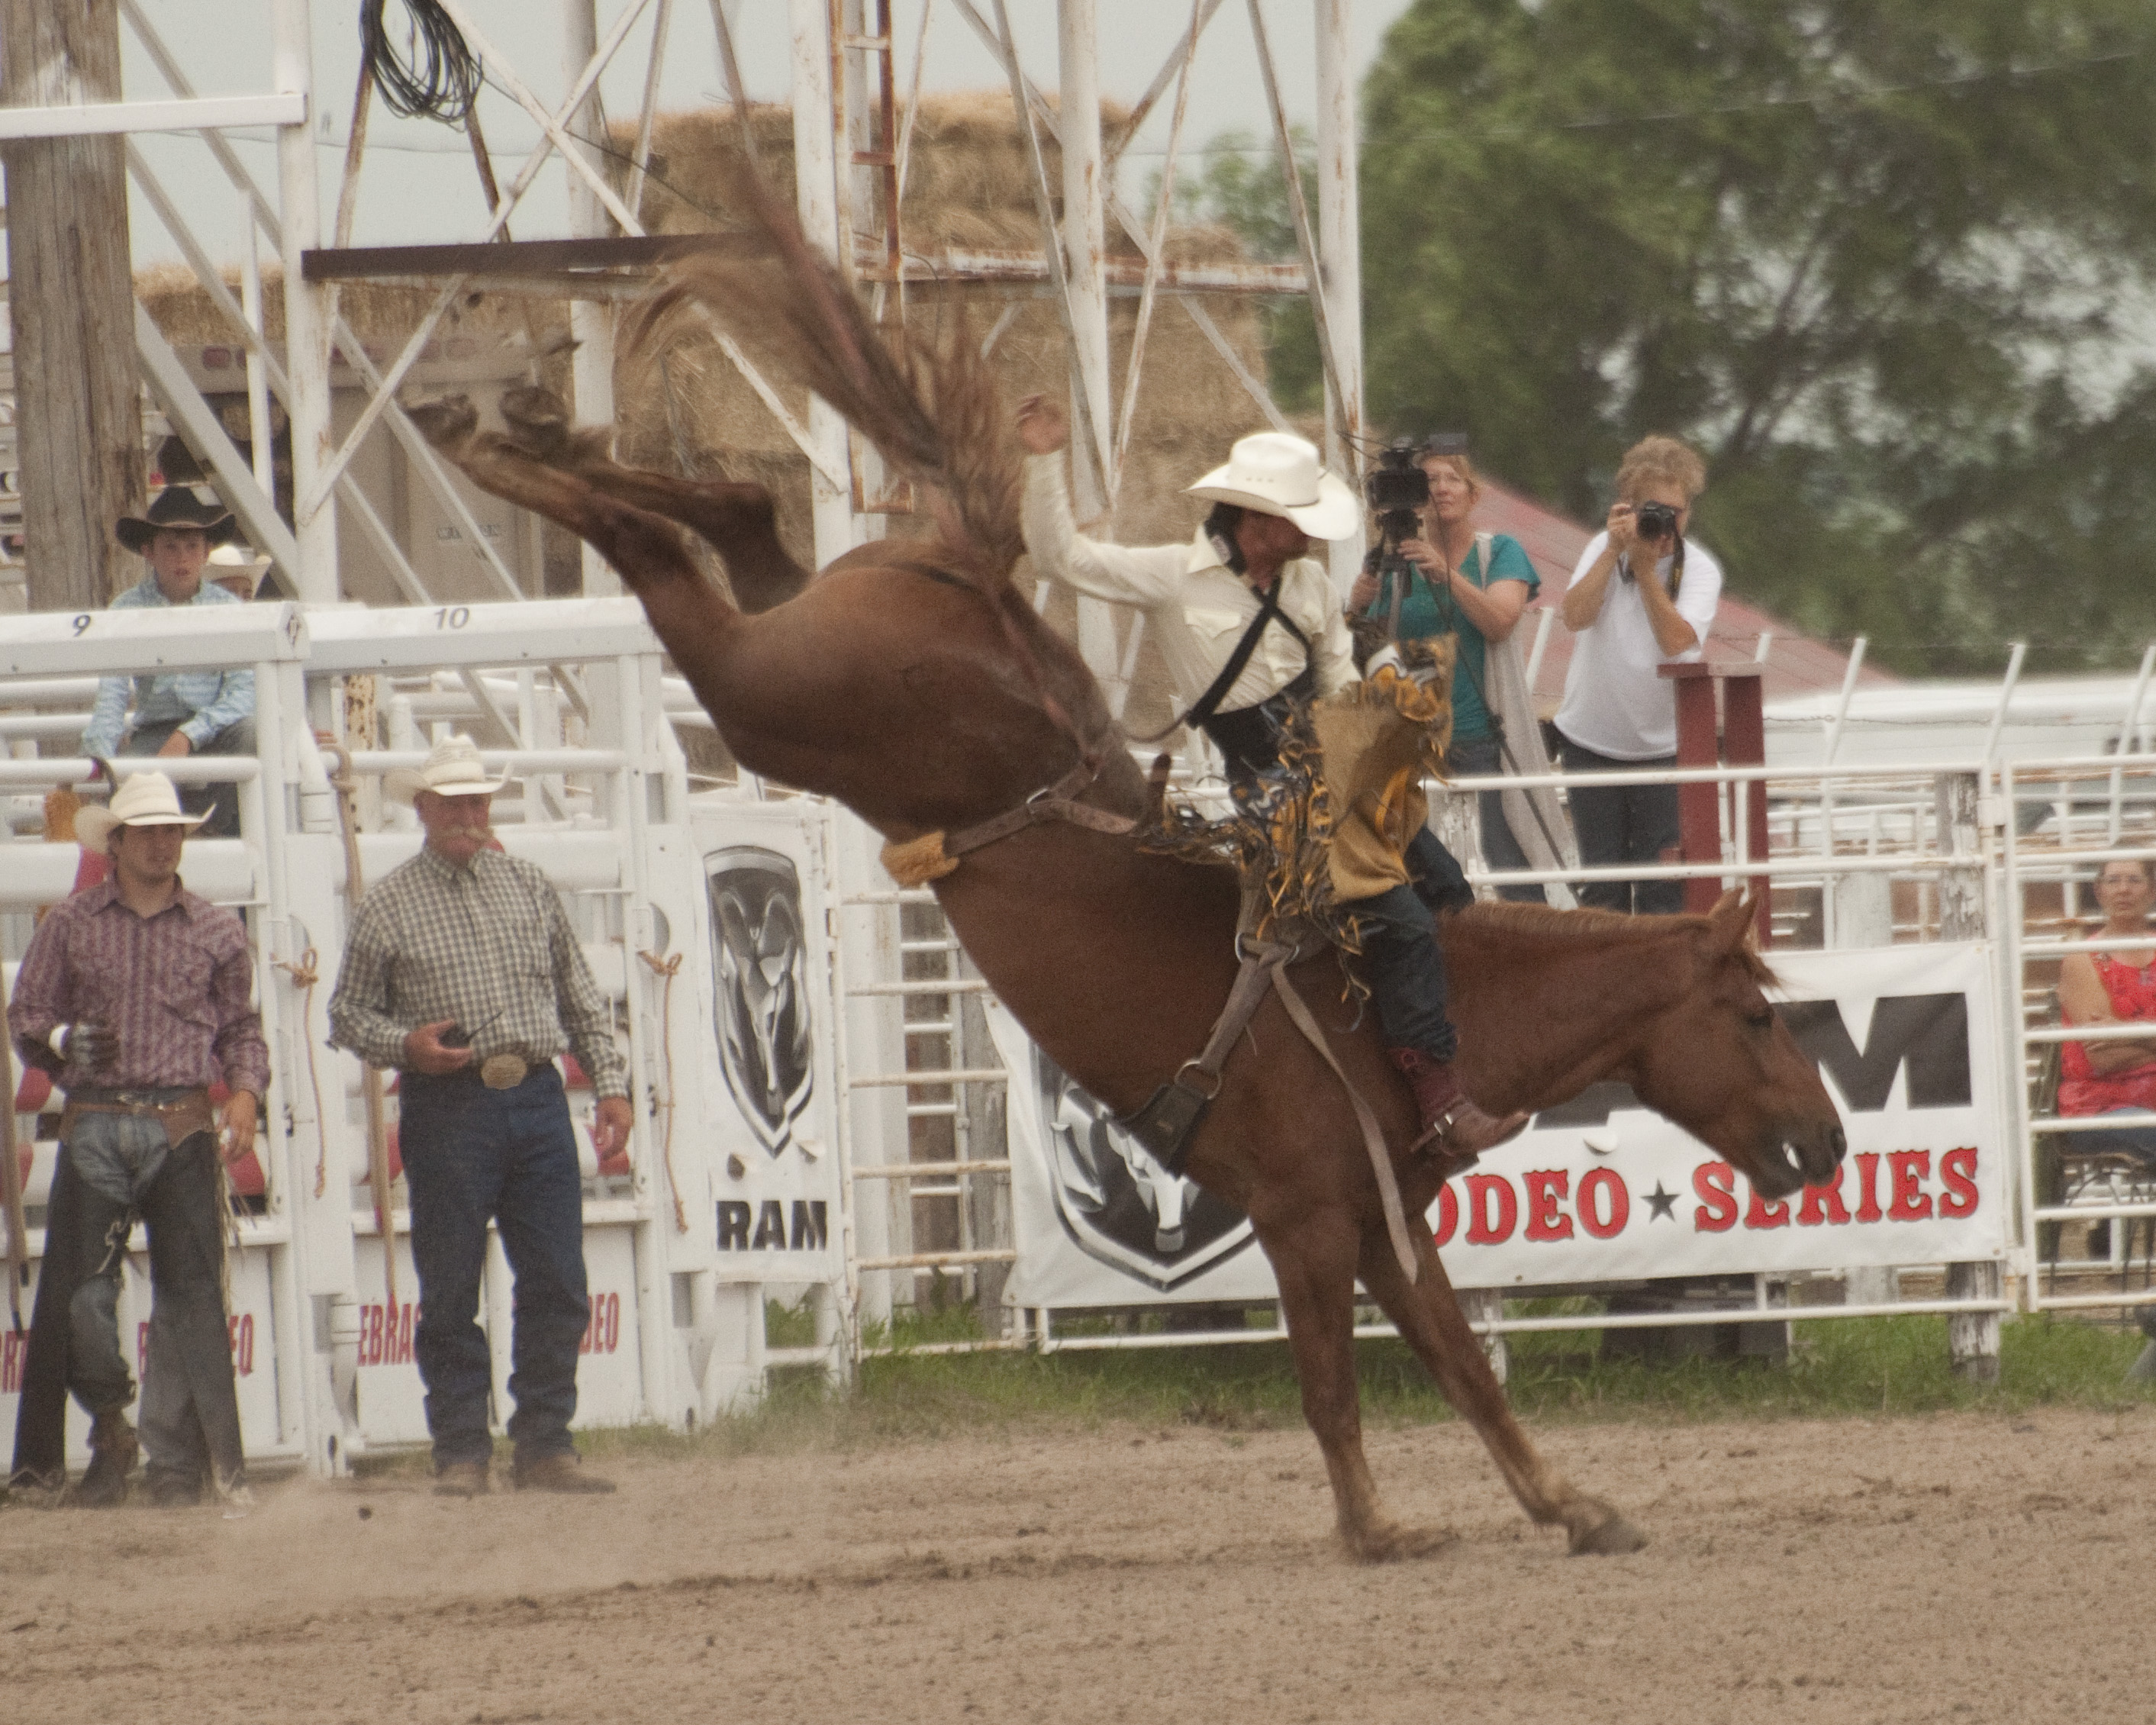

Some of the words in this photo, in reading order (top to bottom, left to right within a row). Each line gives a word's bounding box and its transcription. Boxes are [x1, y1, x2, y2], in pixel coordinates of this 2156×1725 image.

[73, 614, 92, 637] 9
[433, 607, 470, 630] 10
[716, 1199, 827, 1252] RAM
[1432, 1166, 1630, 1249] DEO
[356, 1303, 420, 1366] EBRA
[578, 1292, 619, 1355] DEO
